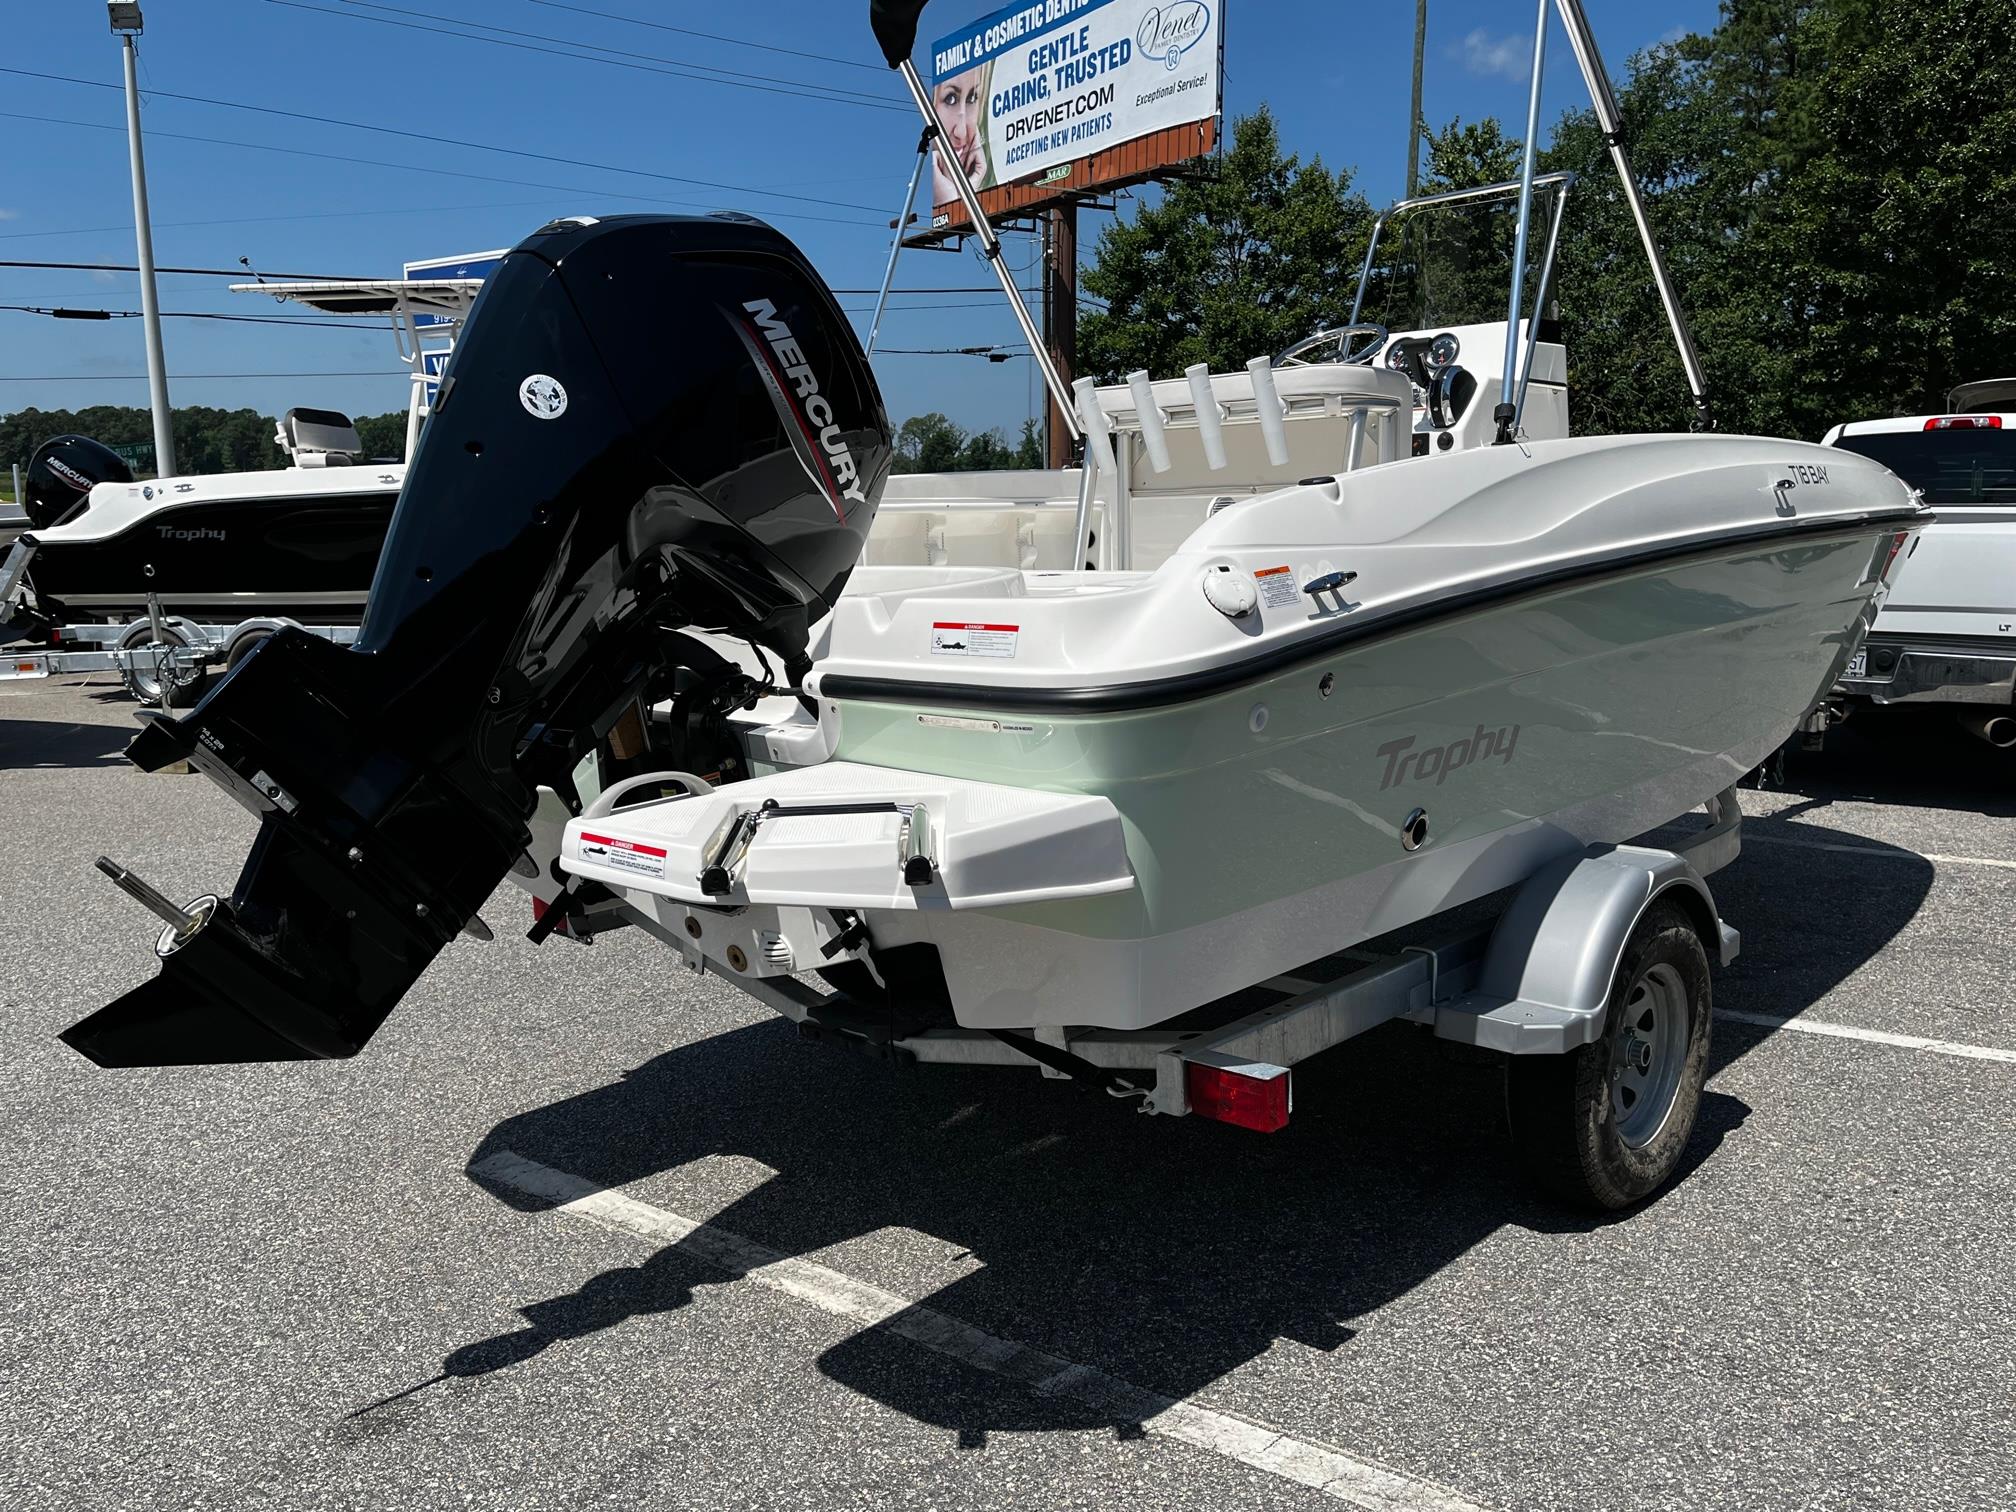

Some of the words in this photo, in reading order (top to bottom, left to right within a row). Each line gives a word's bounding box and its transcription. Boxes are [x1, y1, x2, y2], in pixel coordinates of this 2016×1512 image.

[935, 38, 972, 76] FAMILY
[973, 34, 984, 58] &
[984, 3, 1044, 53] COSMETIC
[1045, 0, 1090, 24] DENT
[1028, 25, 1090, 75] GENTLE
[1137, 4, 1202, 53] Venet
[1154, 38, 1172, 50] FAMILY
[1173, 28, 1200, 44] DENTISTRY
[992, 74, 1051, 118] CARING,
[1055, 37, 1132, 92] TRUSTED
[1135, 82, 1176, 107] Exceptional
[1177, 72, 1208, 93] Service!
[1005, 83, 1114, 142] DRVENET.COM
[1005, 135, 1049, 166] ACCEPTING
[1050, 127, 1070, 150] NEW
[1071, 111, 1113, 143] PATIENTS
[742, 298, 866, 503] MERCURY
[46, 456, 97, 490] MERCURY
[135, 443, 153, 455] HWY
[156, 525, 226, 542] Trophy
[1999, 624, 2012, 632] LT
[1376, 723, 1521, 792] Trophy
[614, 840, 634, 851] DANGER
